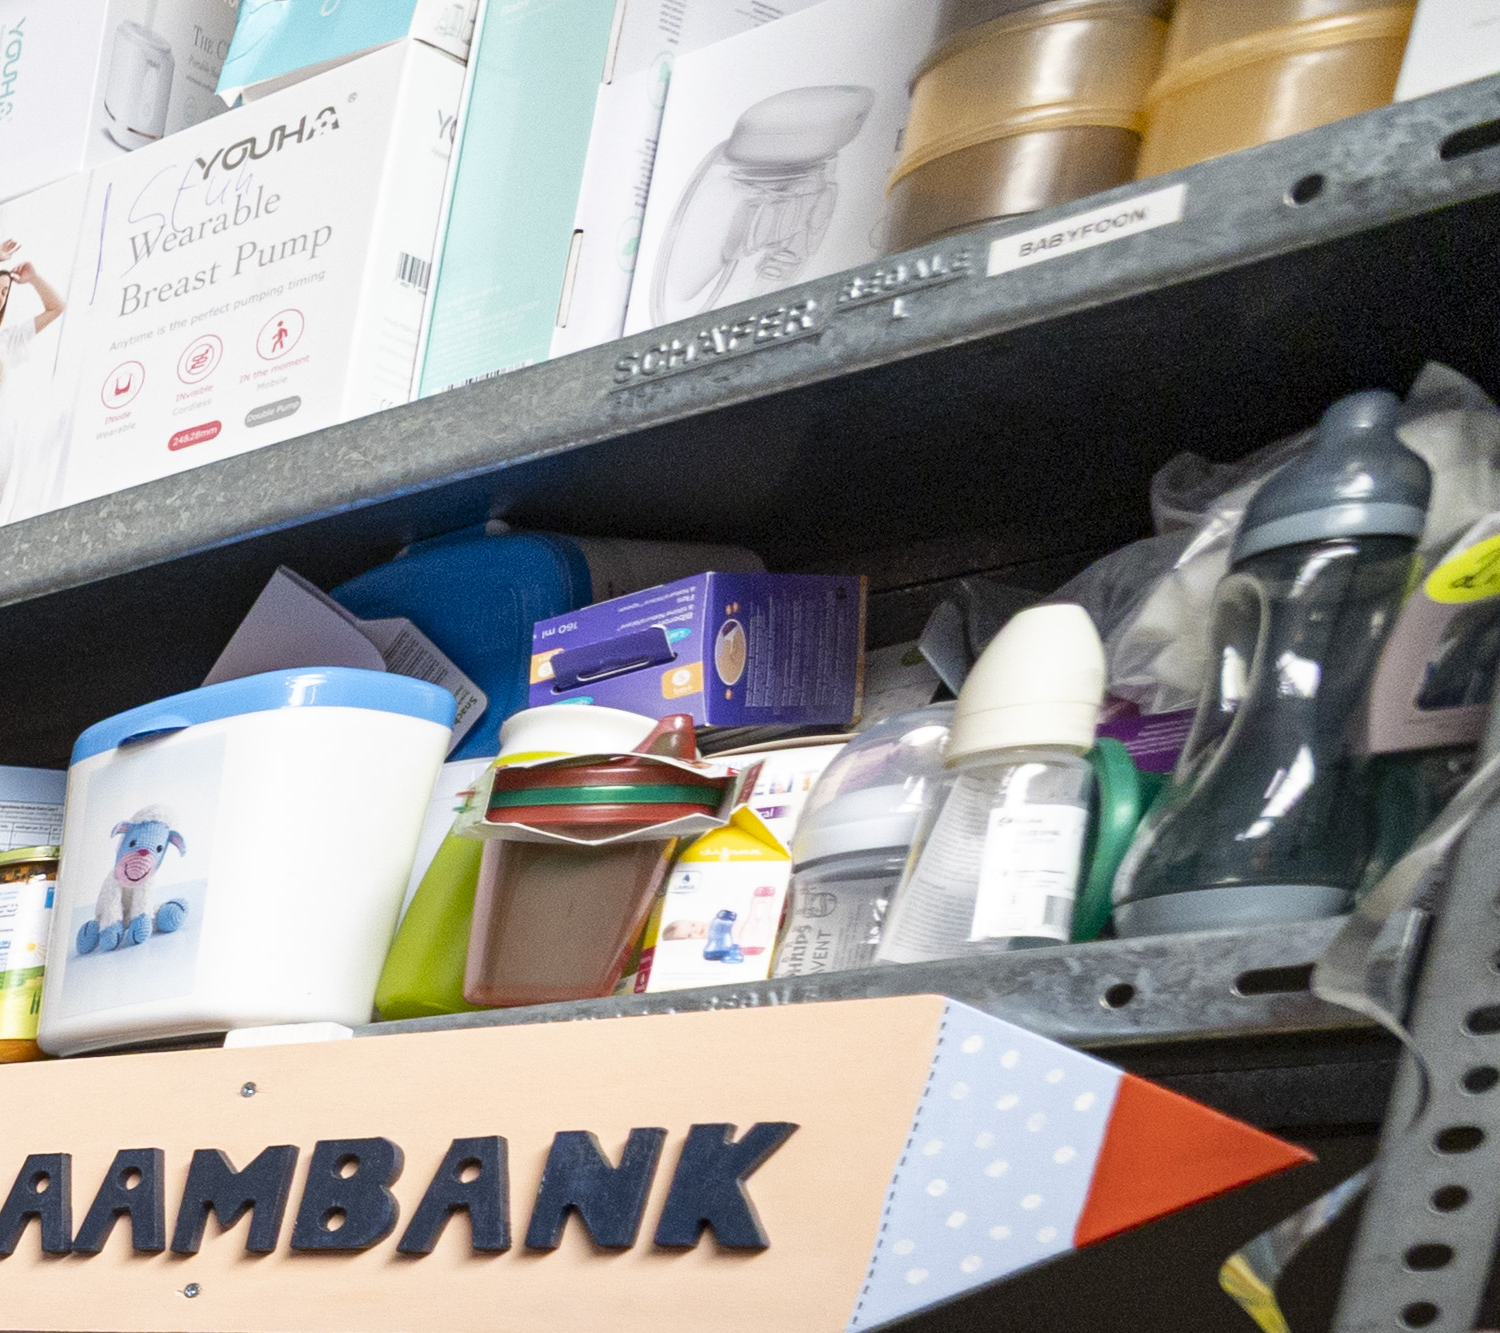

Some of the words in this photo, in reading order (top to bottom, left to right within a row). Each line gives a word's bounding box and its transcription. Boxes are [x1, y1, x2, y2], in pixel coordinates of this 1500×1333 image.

[195, 106, 340, 181] YOUHA
[130, 185, 282, 264] Wearable
[1017, 207, 1152, 260] BABYFOON
[117, 261, 222, 319] Breast
[233, 224, 333, 277] Pump
[109, 331, 154, 352] Anytime
[156, 324, 166, 337] is
[169, 316, 188, 333] the
[190, 302, 231, 327] perfect
[233, 285, 284, 311] pumping
[288, 269, 326, 292] timing
[256, 375, 288, 393] Mobile
[271, 354, 311, 376] moment
[172, 398, 212, 417] Cordless
[558, 619, 579, 636] 160
